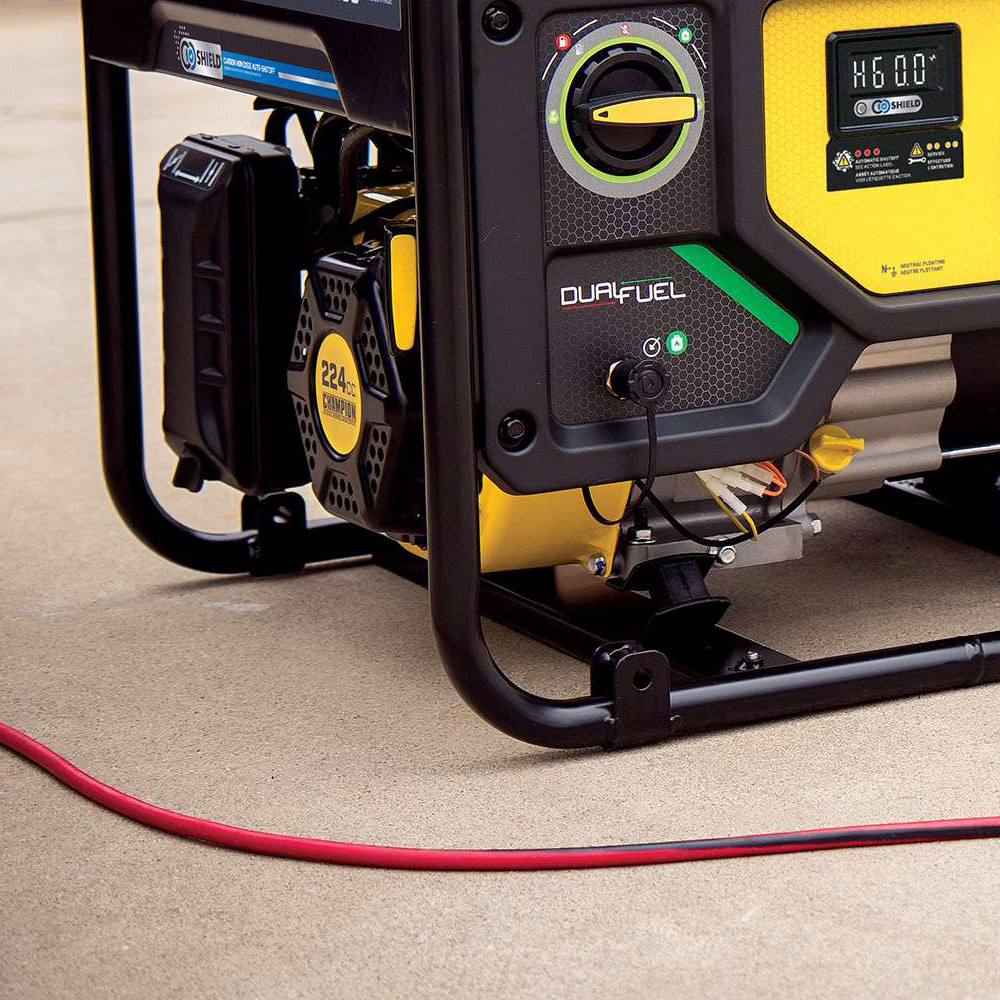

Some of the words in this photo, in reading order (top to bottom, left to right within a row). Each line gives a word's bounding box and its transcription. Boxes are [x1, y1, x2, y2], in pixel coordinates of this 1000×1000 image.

[196, 50, 222, 70] SHIELD
[891, 99, 921, 110] SHIELD
[323, 393, 356, 421] CHAMPION
